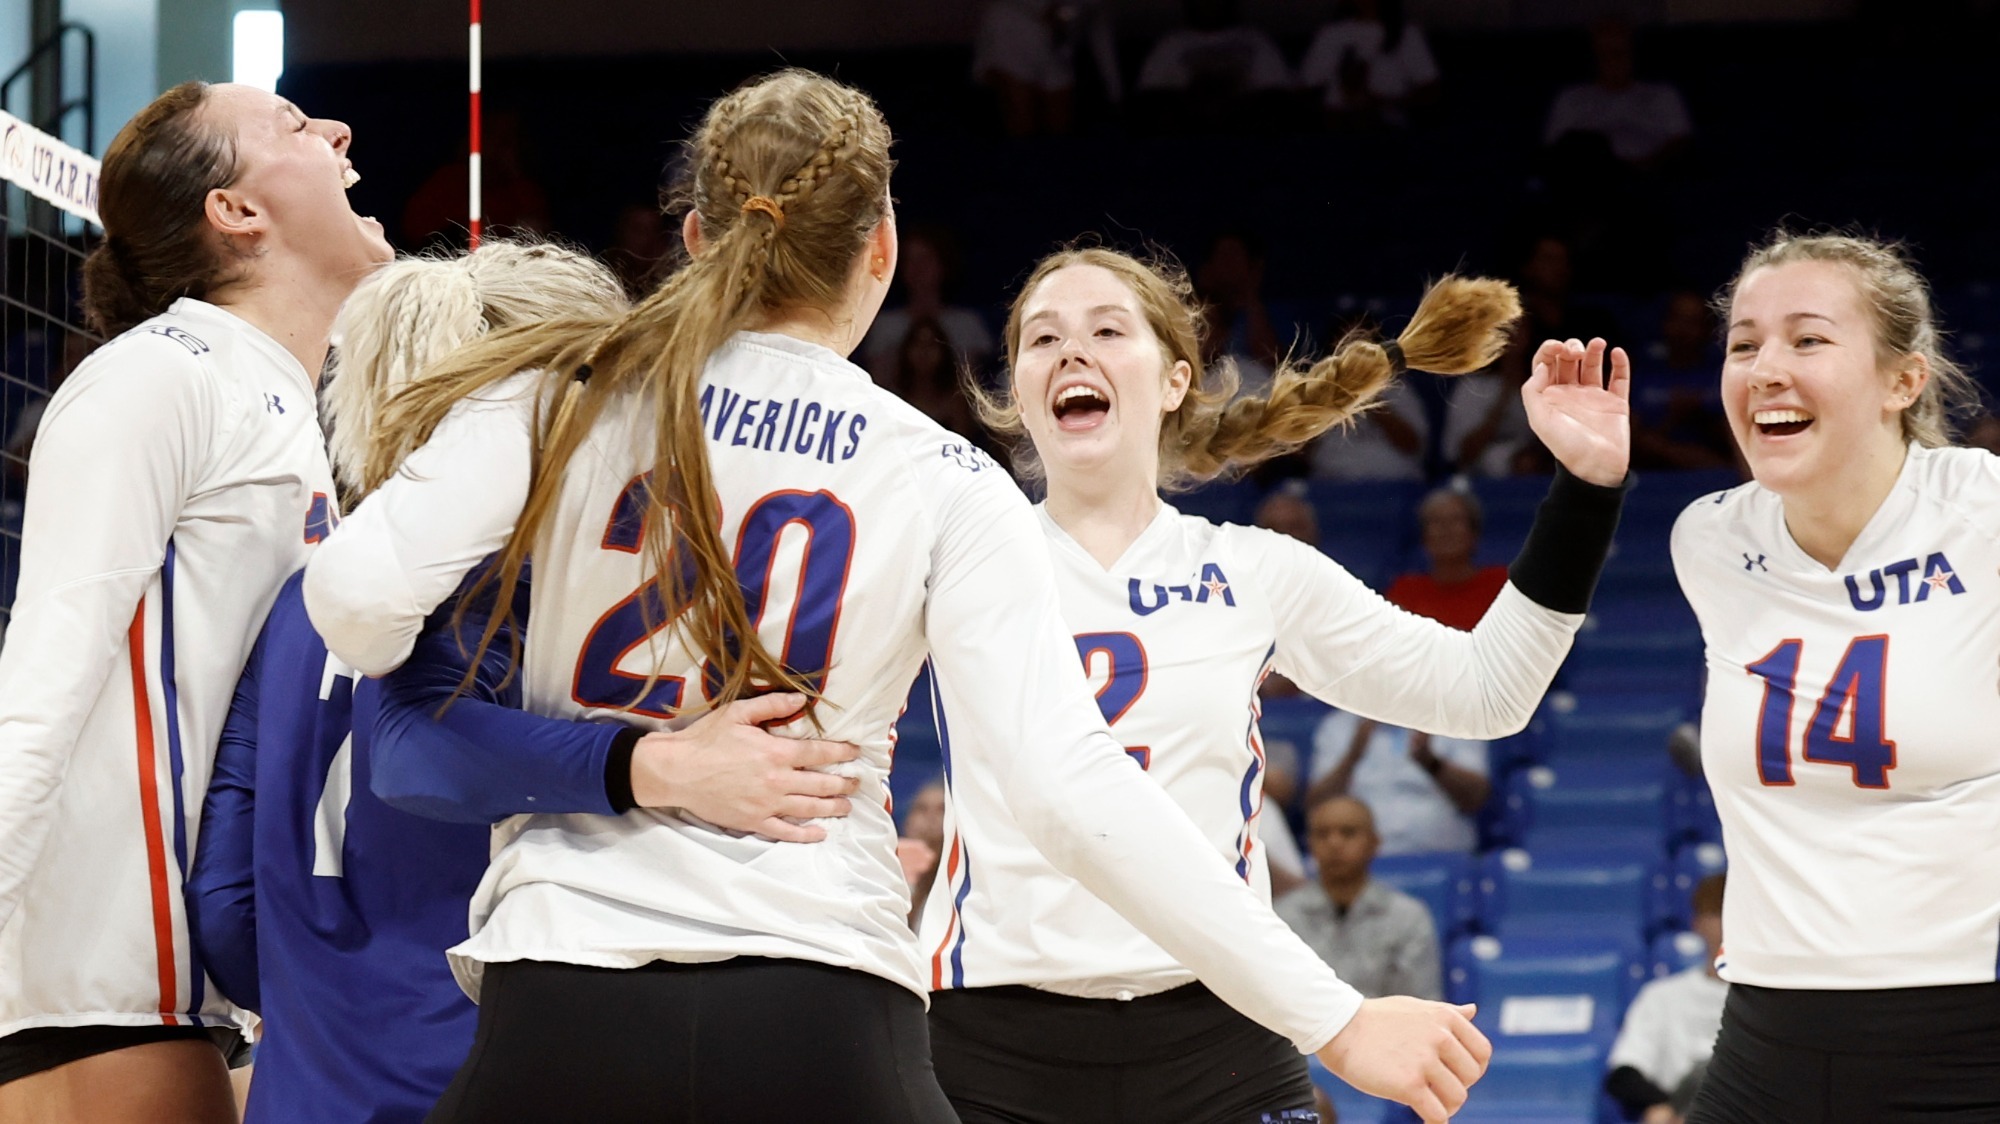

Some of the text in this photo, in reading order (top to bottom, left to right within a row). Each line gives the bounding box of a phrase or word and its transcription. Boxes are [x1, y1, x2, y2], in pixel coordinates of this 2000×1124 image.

[699, 384, 867, 464] AVERICKS
[571, 466, 856, 728] 20
[1844, 551, 1967, 612] UTA
[1744, 633, 1897, 790] 14
